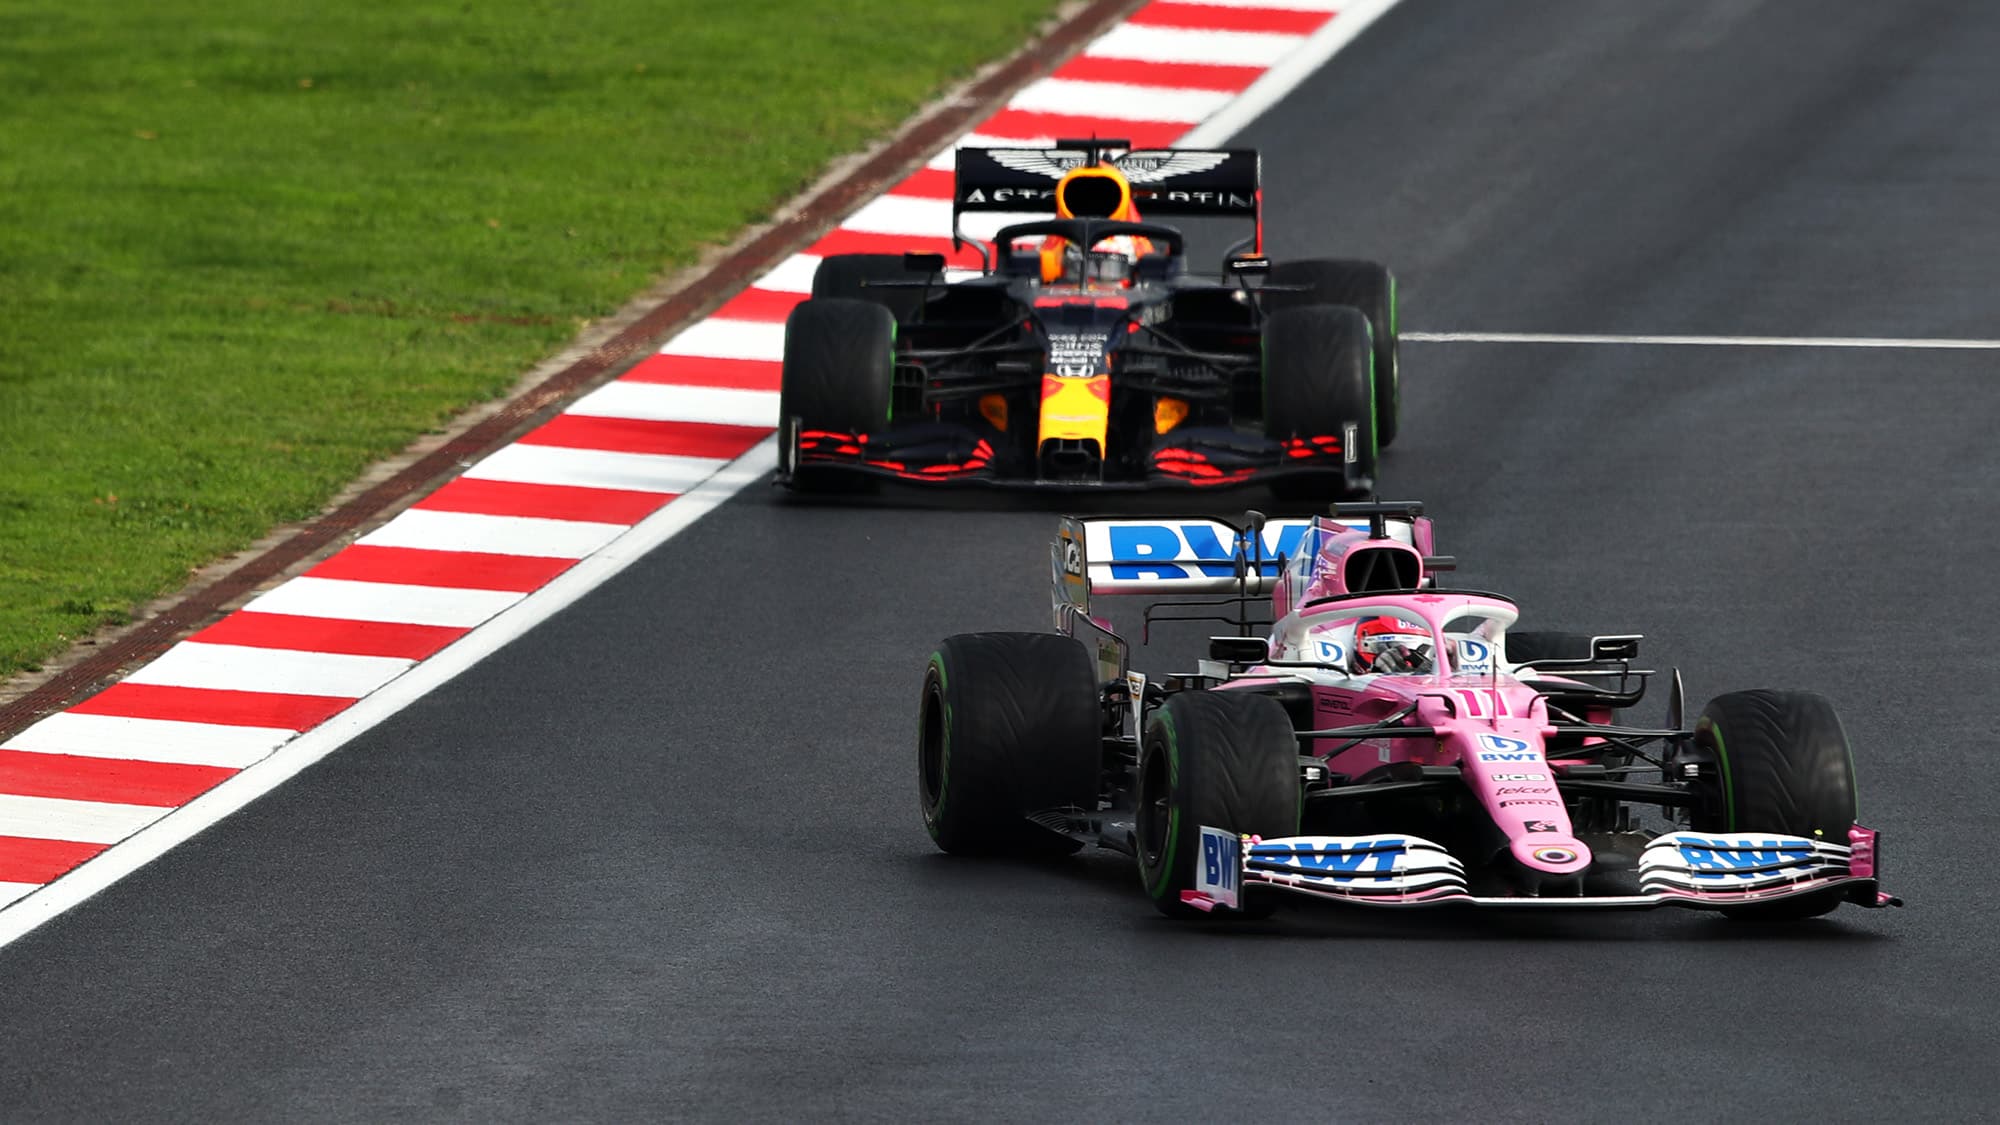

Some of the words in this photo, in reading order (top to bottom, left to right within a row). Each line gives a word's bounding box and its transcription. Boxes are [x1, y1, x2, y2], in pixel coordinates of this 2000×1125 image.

[1455, 688, 1513, 718] 11
[1480, 753, 1538, 761] BWT
[1496, 786, 1552, 796] telcel
[1499, 799, 1559, 808] PIRELLI
[1251, 839, 1406, 882] BWT
[1675, 837, 1815, 879] BWT
